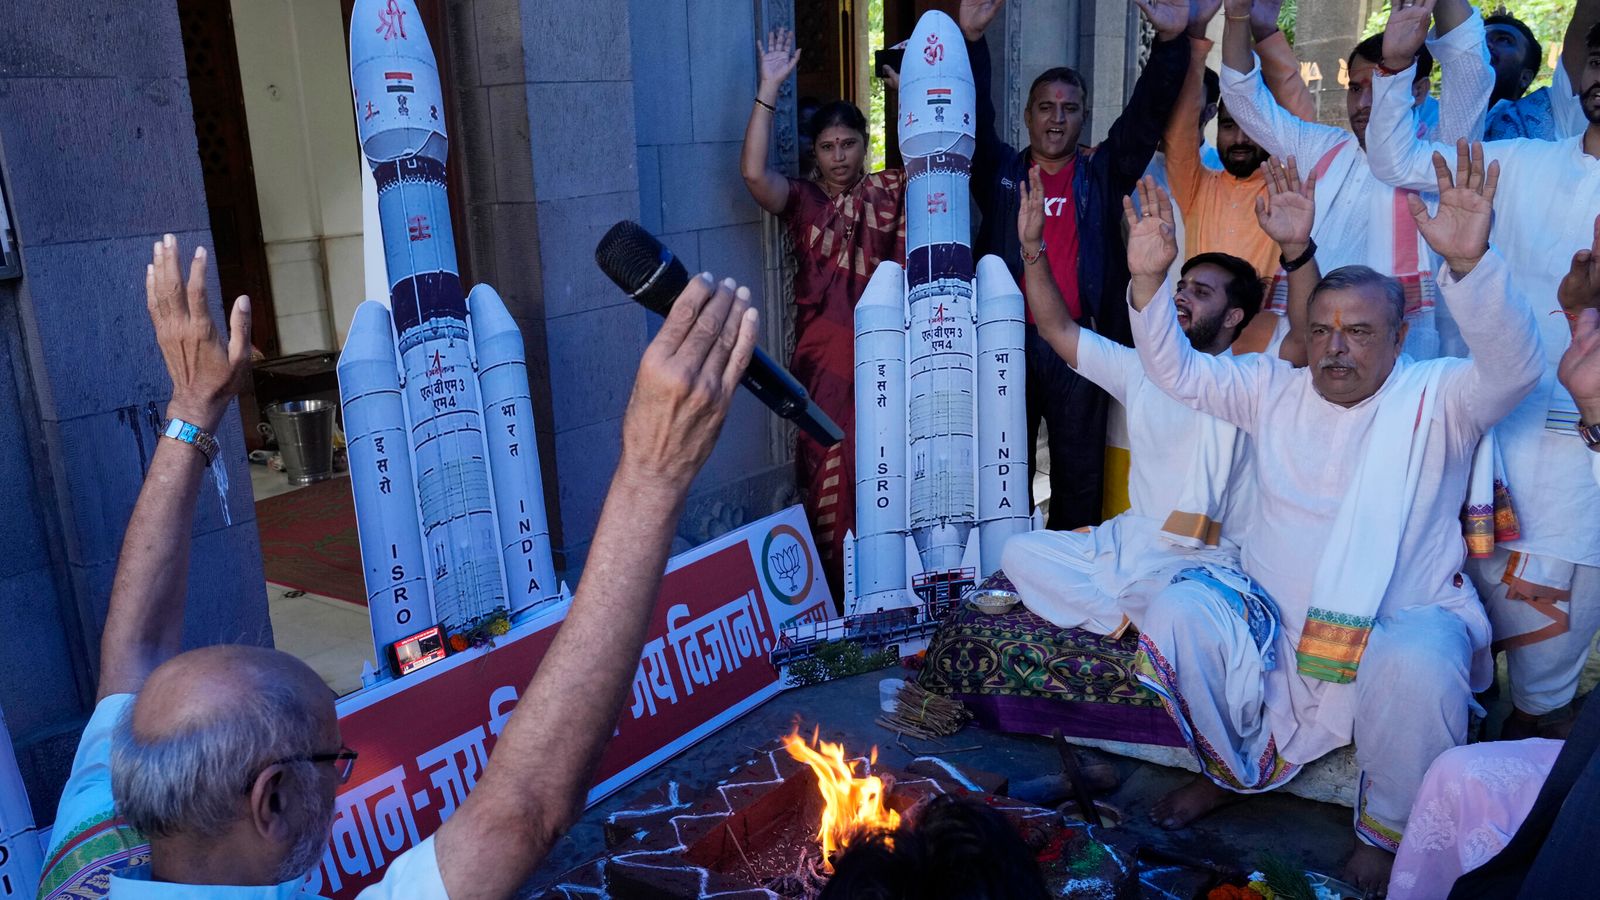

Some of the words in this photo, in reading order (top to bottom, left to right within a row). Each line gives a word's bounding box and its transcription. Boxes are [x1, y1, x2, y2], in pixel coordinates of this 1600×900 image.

[876, 446, 889, 510] ISRO
[998, 431, 1012, 510] INDIA
[391, 543, 412, 626] ISRO
[518, 499, 541, 594] INDIA
